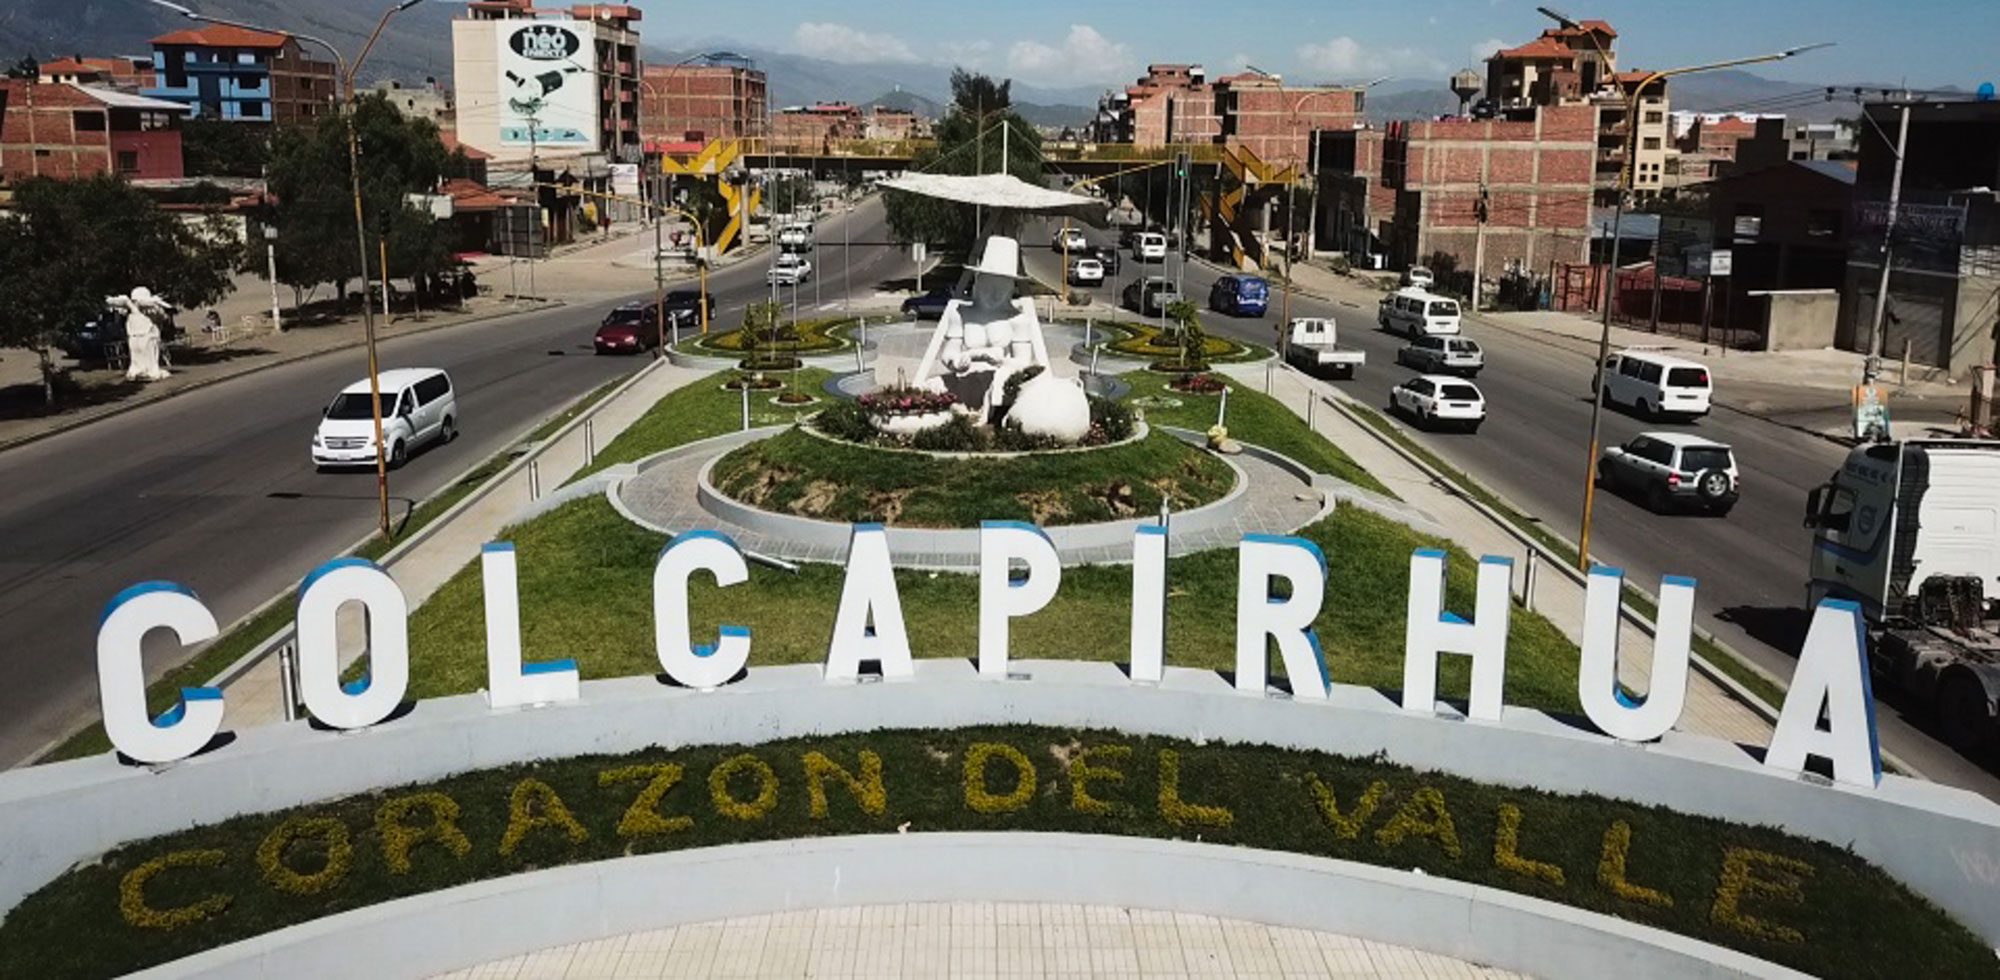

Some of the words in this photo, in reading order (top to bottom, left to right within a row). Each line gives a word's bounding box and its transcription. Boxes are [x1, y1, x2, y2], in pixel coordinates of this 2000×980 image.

[97, 519, 1881, 788] COLCAPIRHUA
[119, 749, 887, 929] CORAZON
[962, 741, 1234, 828] DEL
[1306, 770, 1814, 944] VALLE
